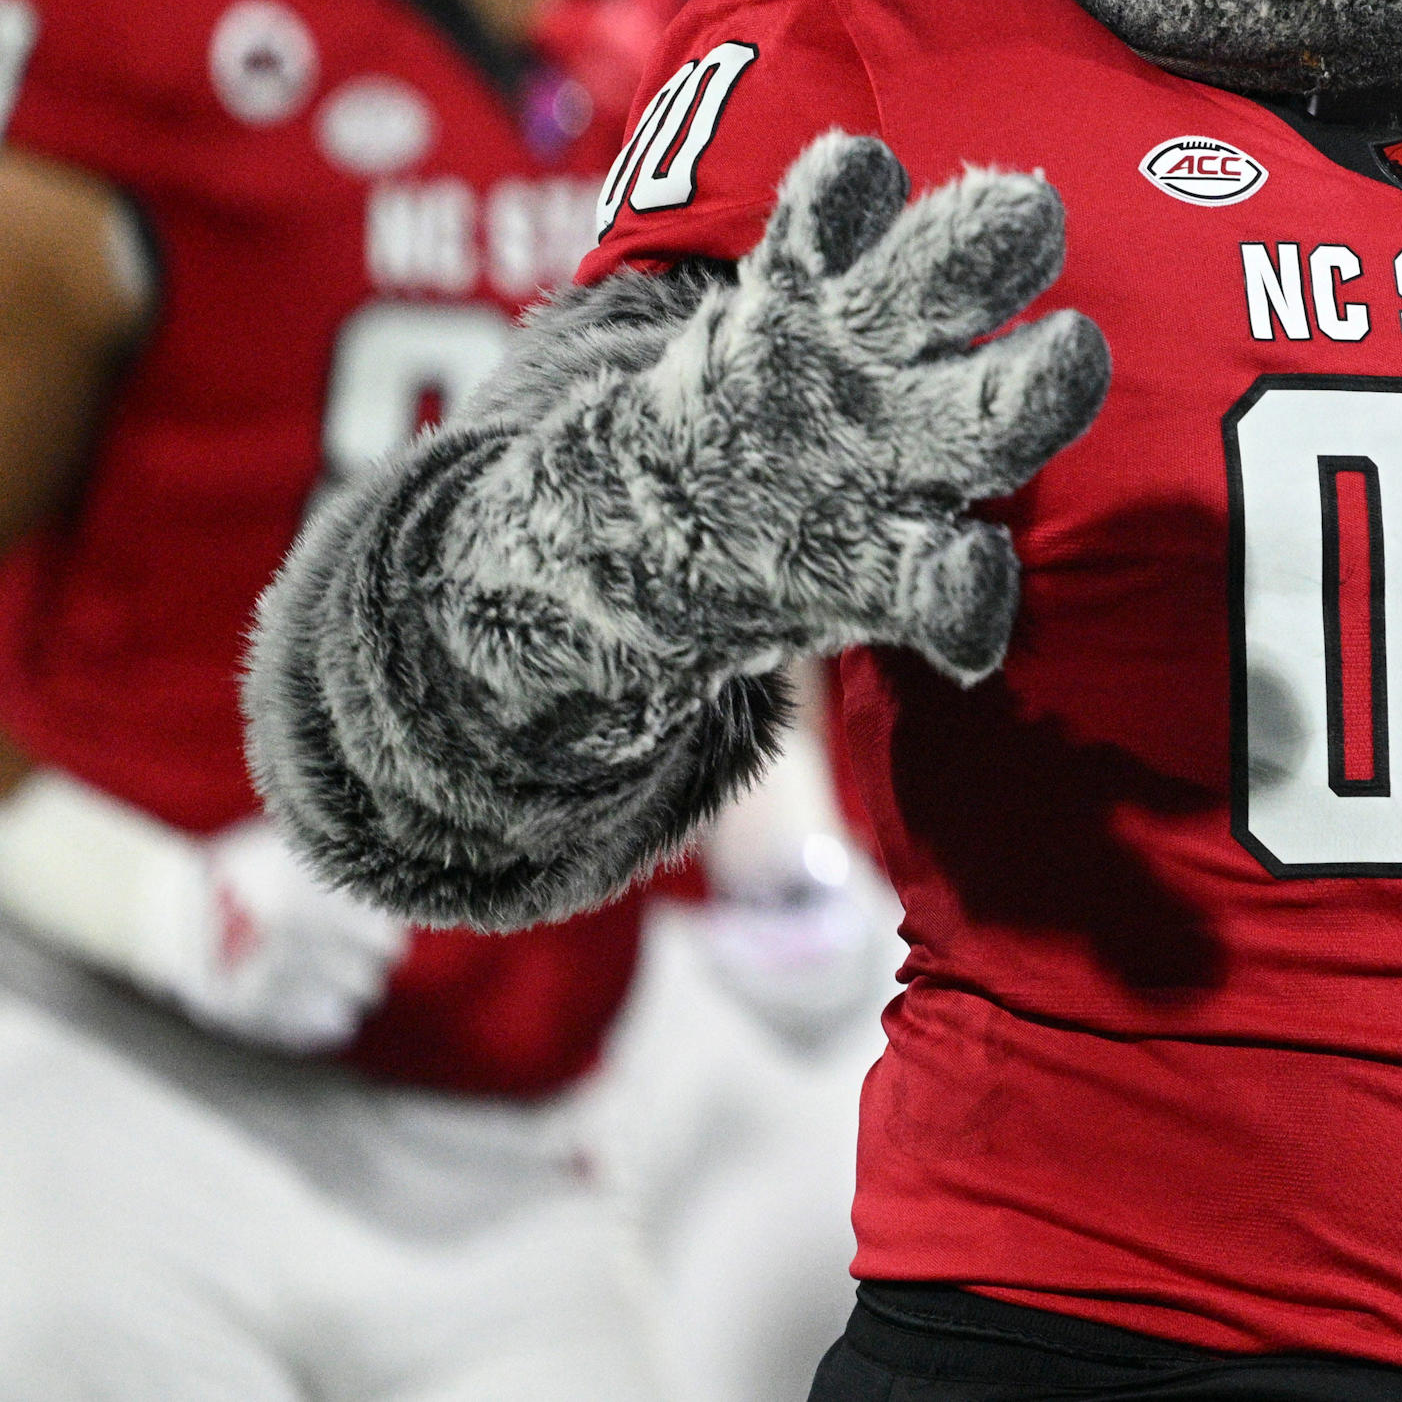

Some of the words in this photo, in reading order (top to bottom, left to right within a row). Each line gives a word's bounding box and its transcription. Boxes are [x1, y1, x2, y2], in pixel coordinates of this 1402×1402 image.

[596, 39, 761, 245] 00
[1165, 154, 1243, 176] ACC
[1239, 241, 1371, 343] NC
